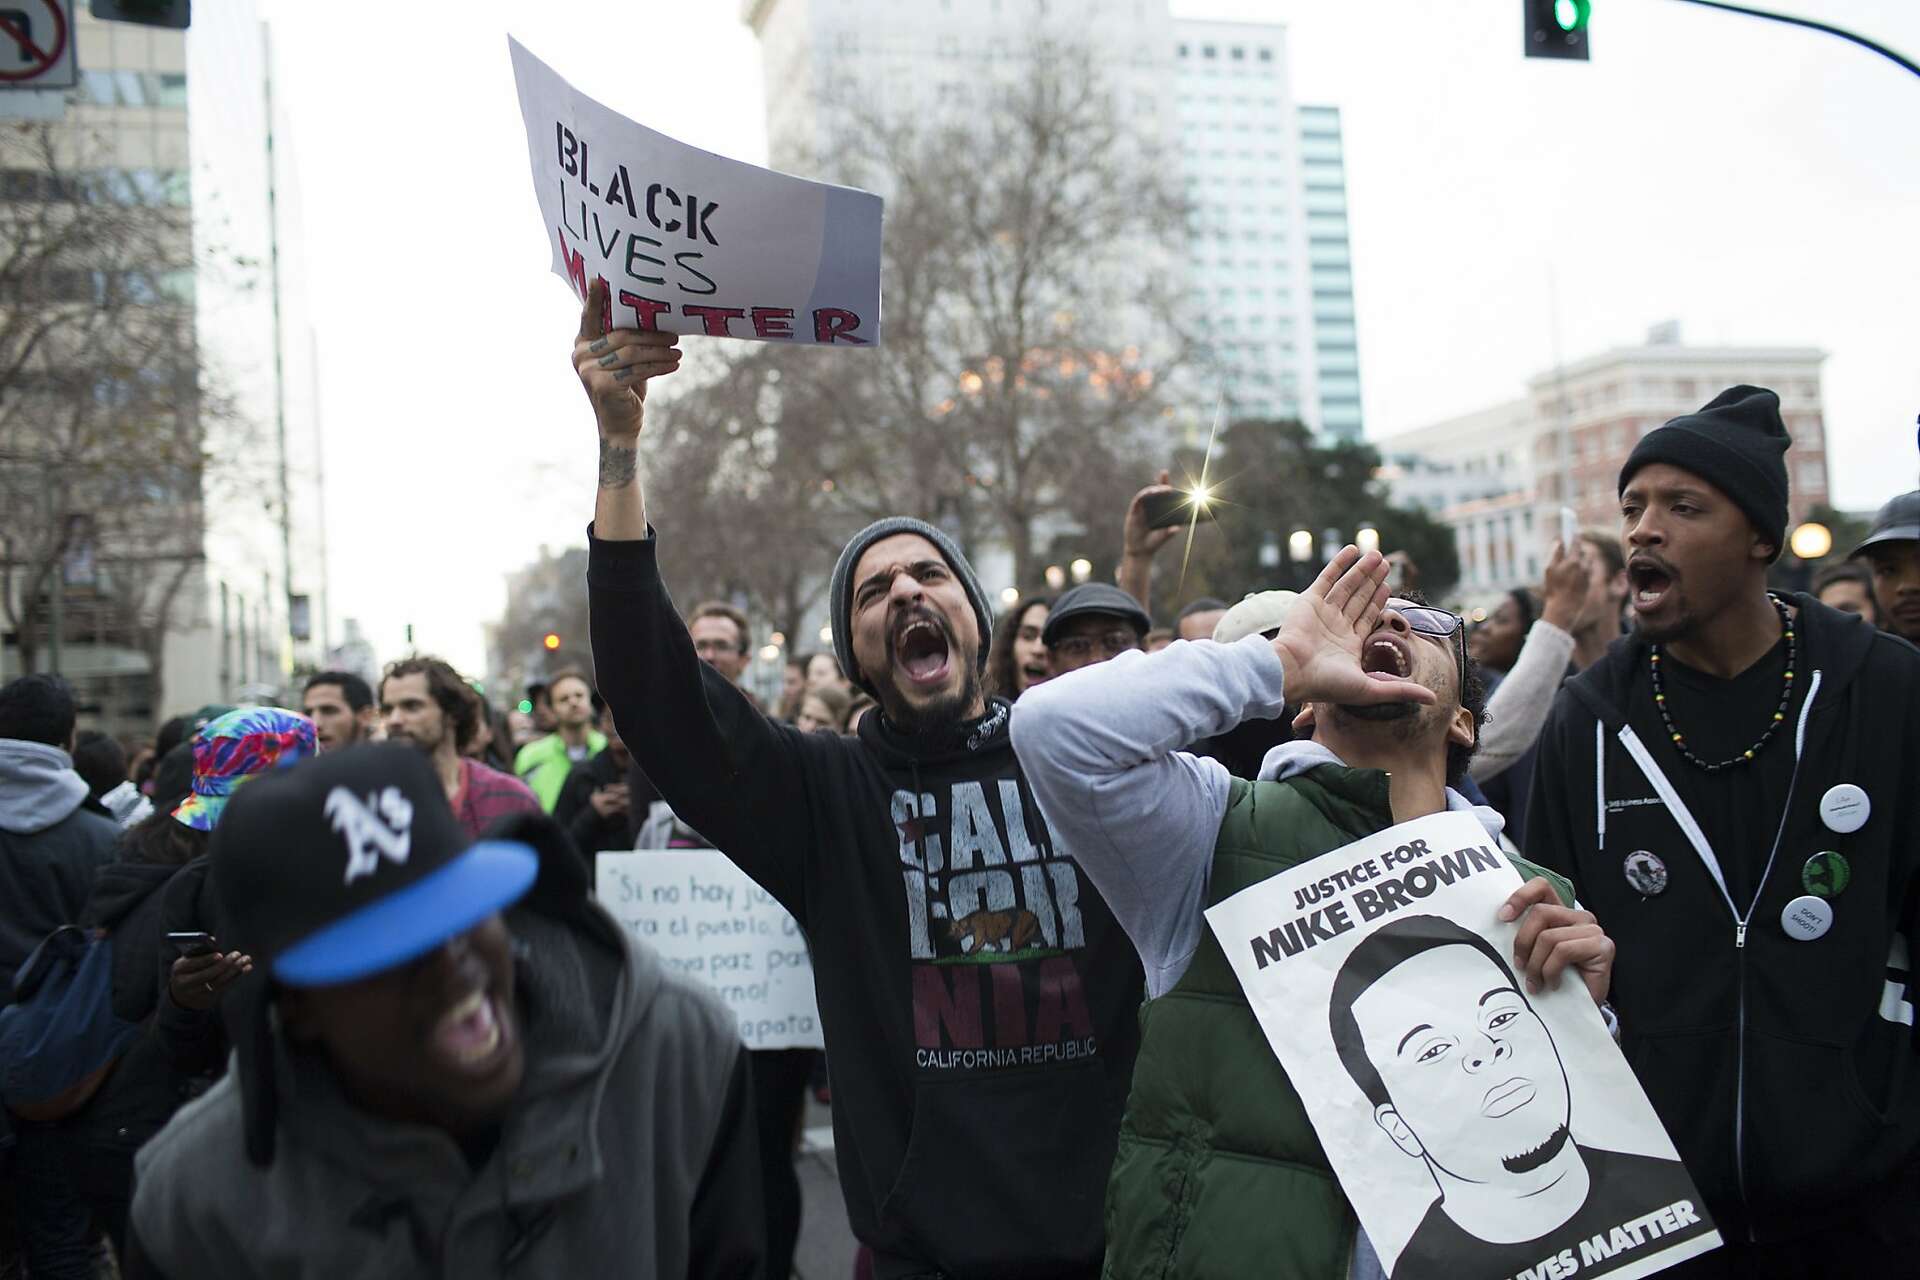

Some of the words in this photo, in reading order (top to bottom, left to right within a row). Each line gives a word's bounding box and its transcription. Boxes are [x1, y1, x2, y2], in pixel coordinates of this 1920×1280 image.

[556, 121, 719, 246] BLACK
[560, 178, 717, 295] LIVES
[890, 779, 1073, 874] CAL
[652, 885, 681, 904] no
[690, 874, 734, 911] hay
[902, 860, 1087, 960] FOR
[1250, 904, 1355, 970] MIKE
[1352, 845, 1503, 923] BROWN
[1294, 859, 1382, 911] JUSTICE
[1381, 838, 1433, 872] FOR
[669, 915, 689, 936] el
[710, 953, 753, 978] paz
[911, 955, 1094, 1049] NIA
[916, 1048, 1018, 1069] CALIFORNIA
[1021, 1037, 1097, 1065] REPUBLIC
[1579, 1199, 1701, 1267] MATTER
